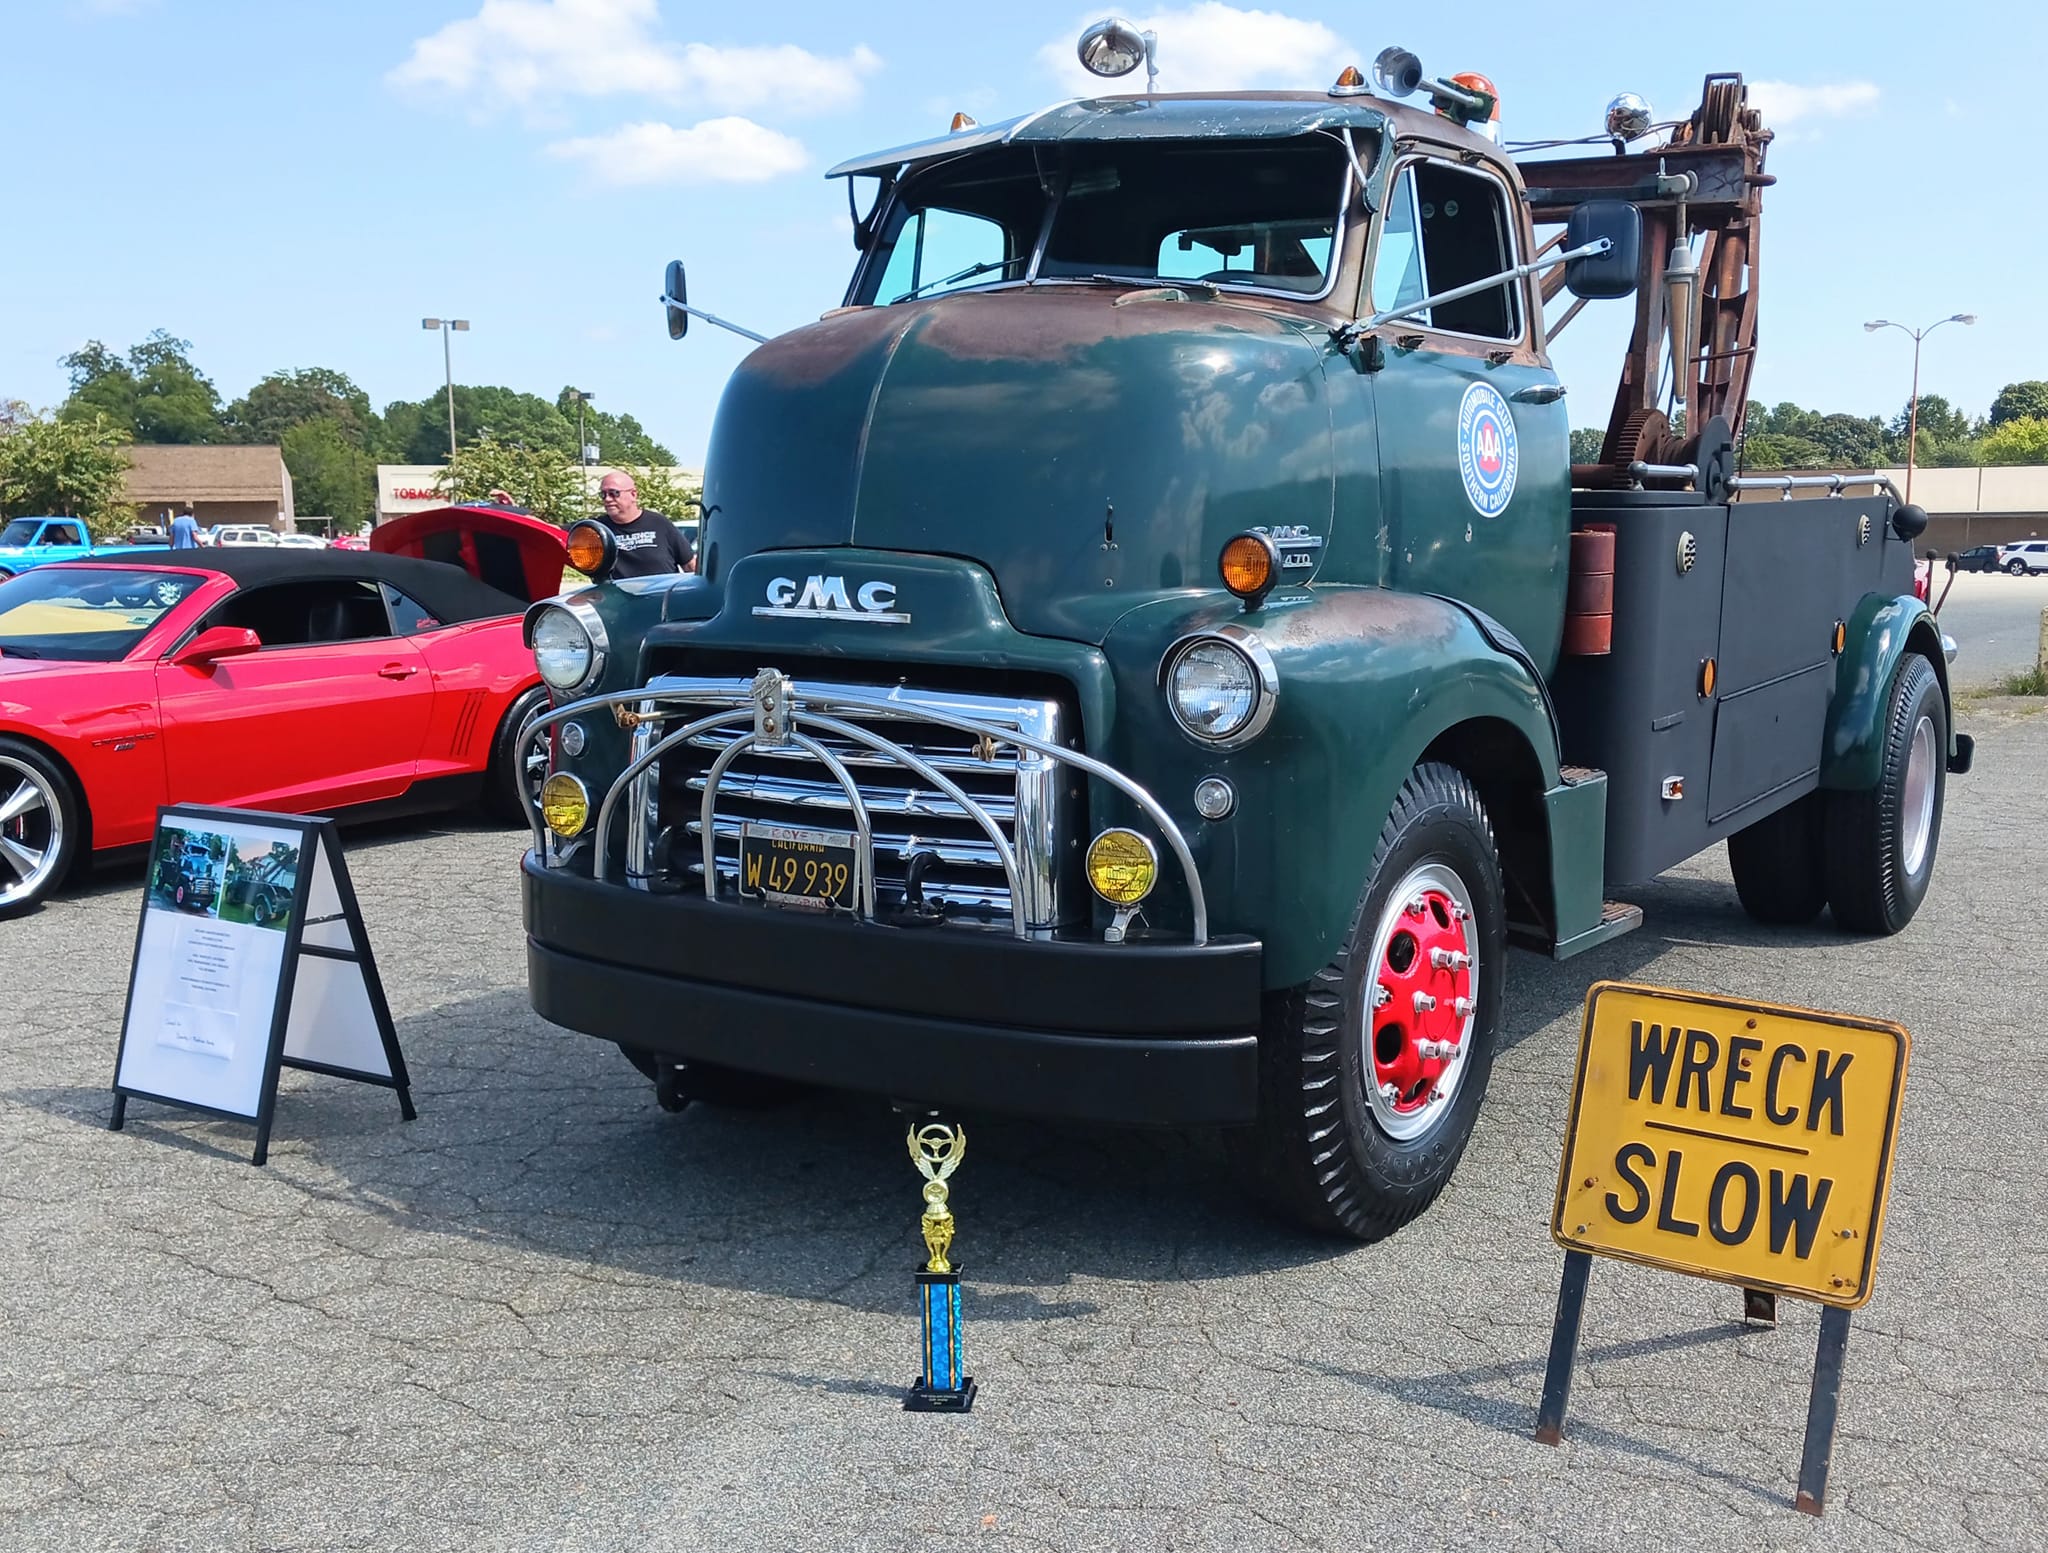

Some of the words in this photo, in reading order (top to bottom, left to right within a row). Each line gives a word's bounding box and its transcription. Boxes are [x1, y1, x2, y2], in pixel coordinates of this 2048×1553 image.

[1462, 387, 1496, 435] AUTOMOBILE
[1496, 402, 1513, 437] CLUB
[1477, 428, 1502, 463] AAA
[1462, 443, 1489, 510] SOUTHERN
[1489, 445, 1515, 511] CALIFORNIA
[766, 574, 897, 613] GMC
[771, 839, 825, 853] CALIFORNIA
[1627, 1019, 1855, 1137] WRECK
[1604, 1142, 1834, 1260] SLOW
